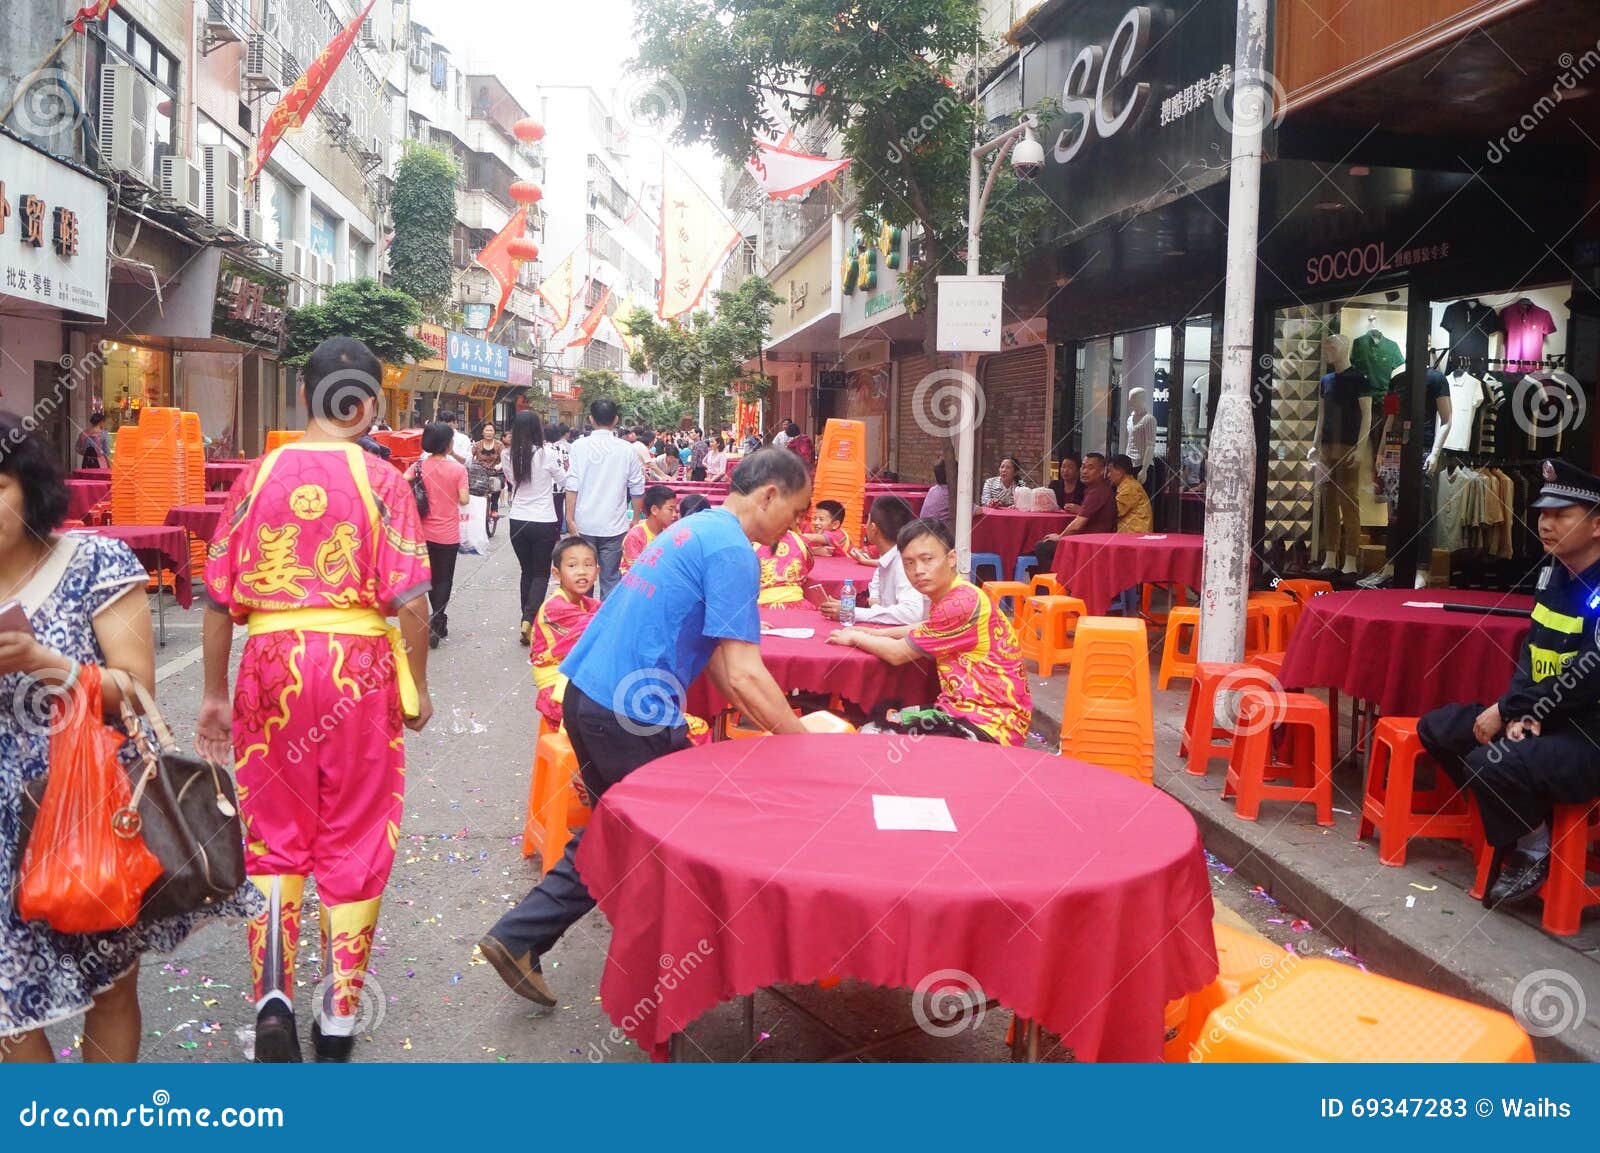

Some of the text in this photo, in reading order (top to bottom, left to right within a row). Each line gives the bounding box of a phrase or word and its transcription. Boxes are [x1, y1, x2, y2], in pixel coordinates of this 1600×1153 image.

[1054, 6, 1151, 164] SC
[1306, 240, 1392, 285] SOCOOL
[240, 524, 361, 597] 姜氏
